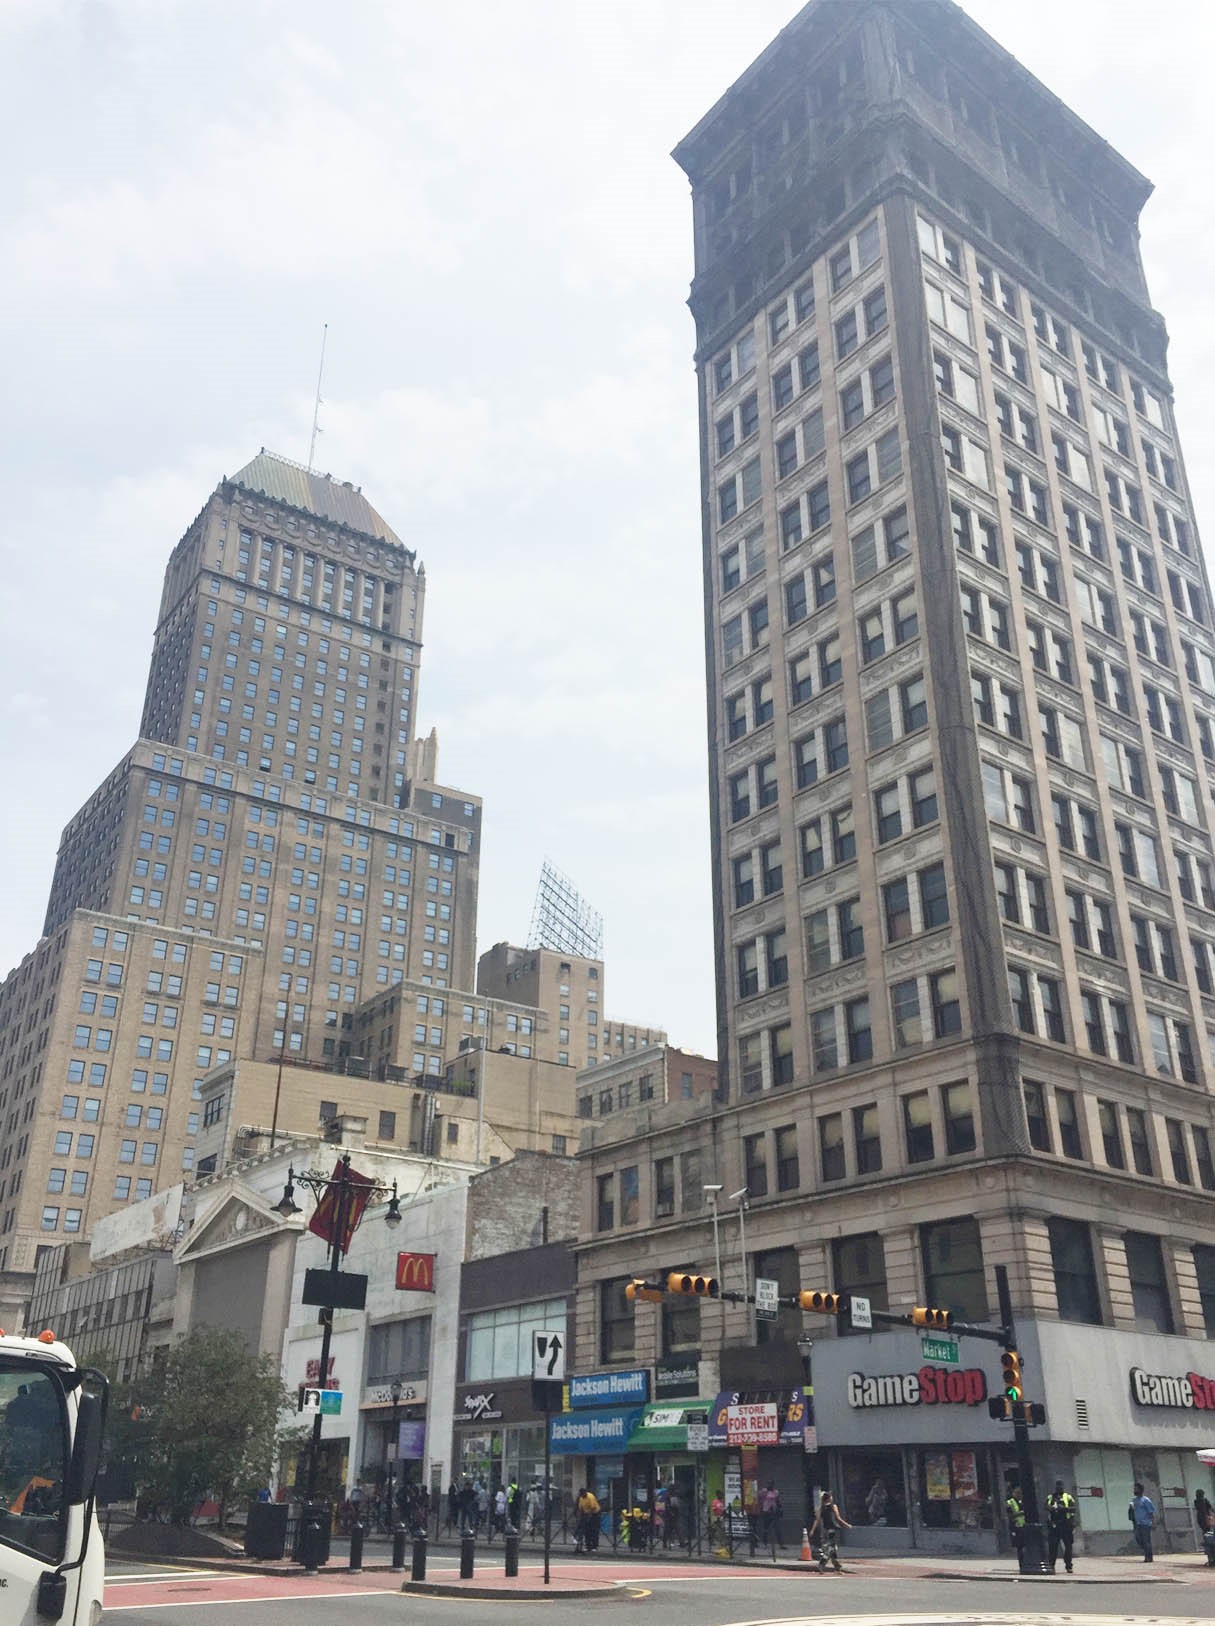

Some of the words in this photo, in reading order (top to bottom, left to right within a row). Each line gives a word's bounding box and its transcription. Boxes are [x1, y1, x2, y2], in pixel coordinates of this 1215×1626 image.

[856, 1302, 866, 1312] NO
[853, 1314, 871, 1324] TURNS
[923, 1341, 951, 1360] Market
[571, 1379, 609, 1397] Jackson
[610, 1373, 643, 1393] Hewitt
[847, 1365, 987, 1408] GameStop
[738, 1405, 766, 1416] STORE
[551, 1422, 590, 1440] Jackson
[590, 1417, 624, 1437] Hewitt
[728, 1417, 749, 1431] FOR
[750, 1415, 777, 1430] RENT
